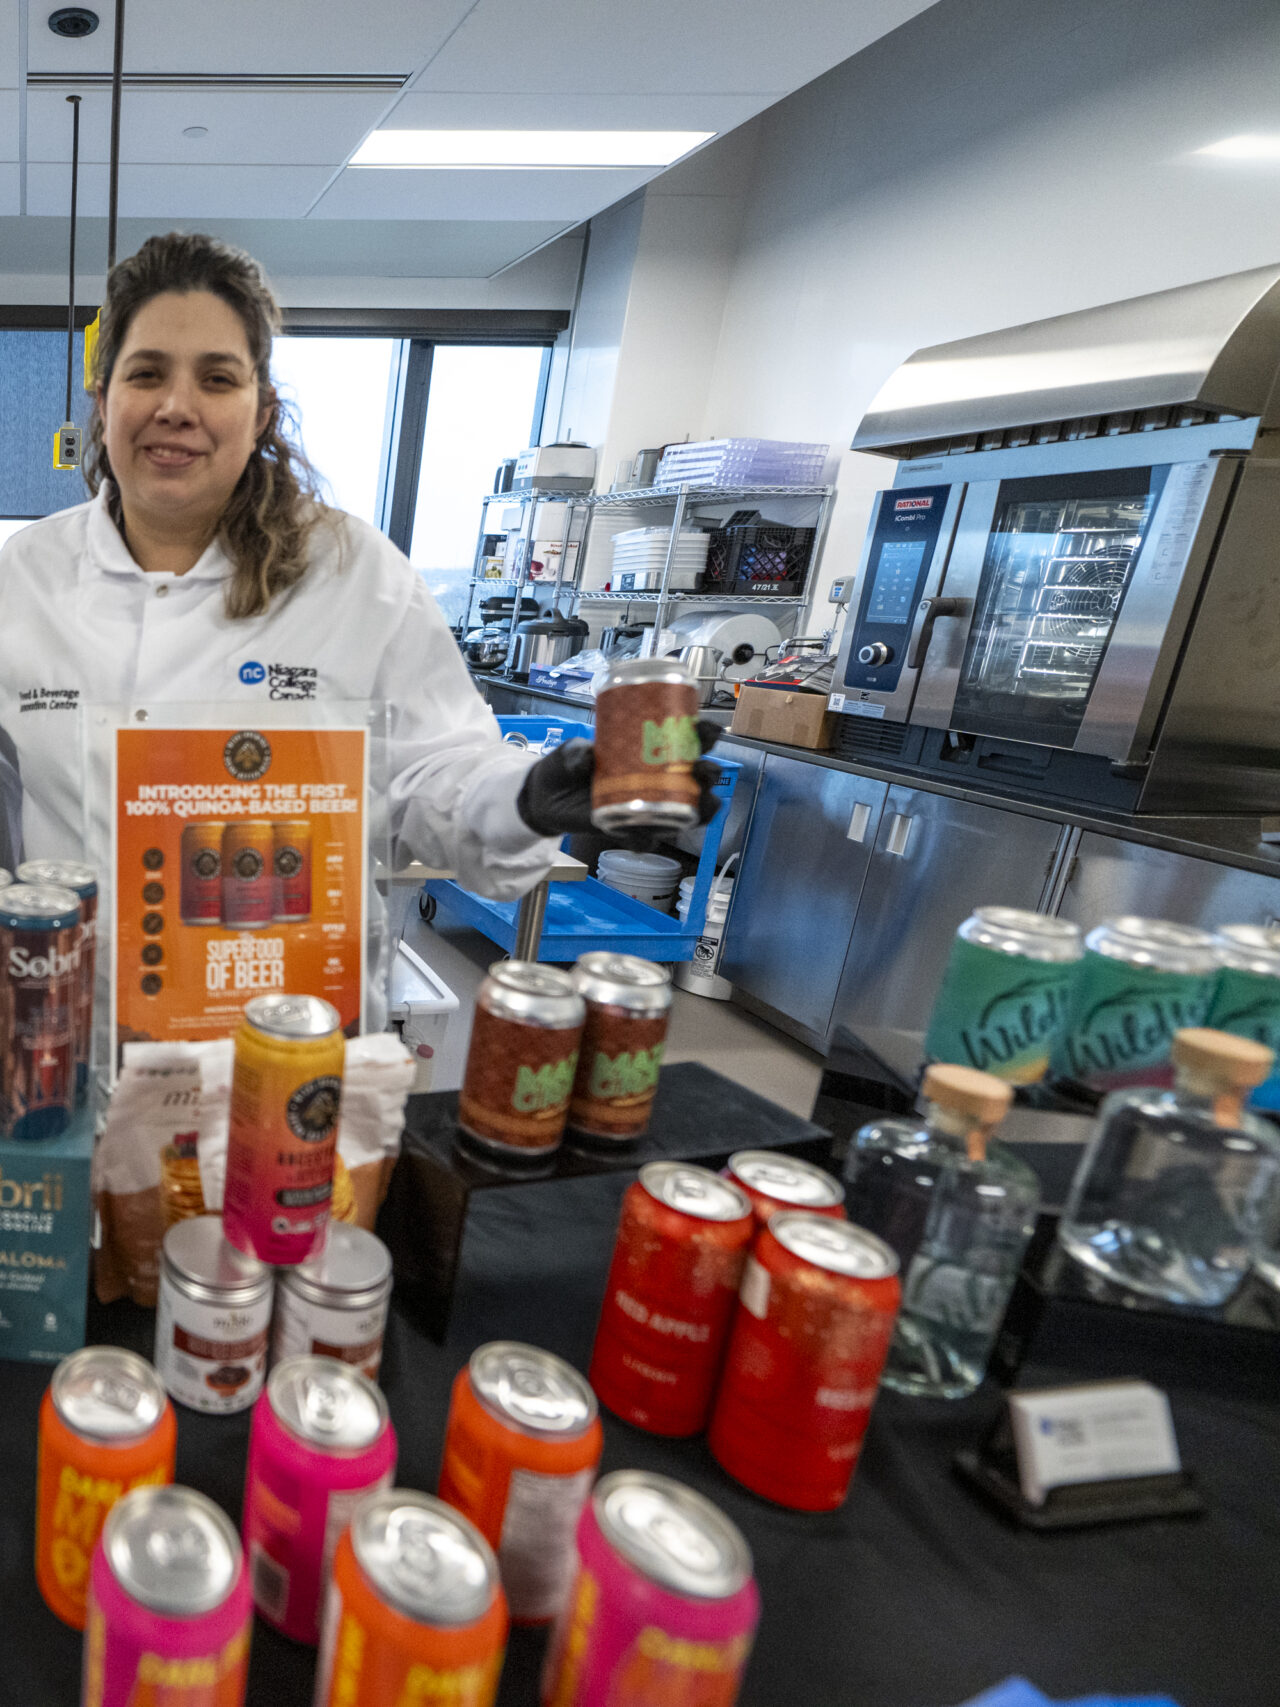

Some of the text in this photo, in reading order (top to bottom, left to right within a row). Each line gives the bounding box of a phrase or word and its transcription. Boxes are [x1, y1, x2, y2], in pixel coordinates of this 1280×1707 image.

[897, 500, 929, 508] RATIONAL
[268, 664, 317, 678] Niagara
[138, 783, 347, 800] INTRODUCING THE FIRST
[125, 799, 358, 817] 100% QUINOA-BASED BEER!
[206, 938, 285, 962] SUPERFOOD
[206, 958, 285, 991] OF BEER
